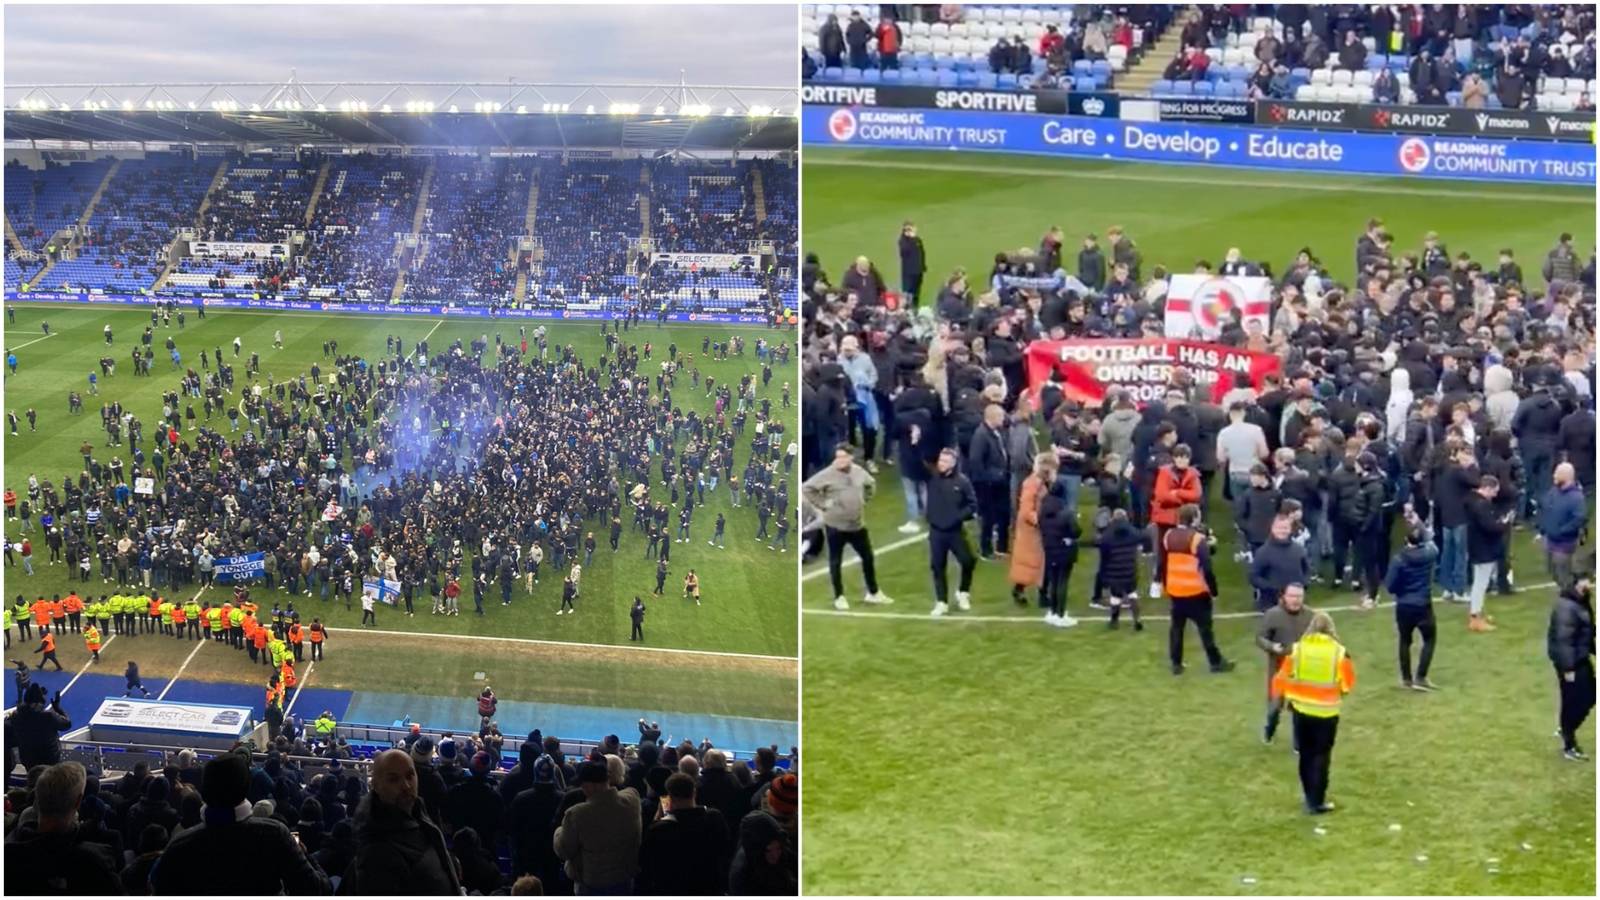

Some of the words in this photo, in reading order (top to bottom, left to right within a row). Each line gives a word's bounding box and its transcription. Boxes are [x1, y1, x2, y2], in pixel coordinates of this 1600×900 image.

[802, 86, 876, 105] ORTFIVE
[935, 90, 1037, 111] SPORTFIVE
[1183, 102, 1199, 114] FOR
[859, 112, 908, 123] READING
[910, 114, 924, 124] FC
[1287, 108, 1342, 122] RAPIDZ
[1392, 113, 1447, 127] RAPIDZ
[1489, 117, 1530, 128] macron
[1560, 120, 1593, 131] macro
[859, 125, 953, 141] COMMUNITY
[957, 127, 1007, 144] TRUST
[1043, 121, 1096, 145] Care
[1124, 126, 1220, 159] Develop
[1249, 134, 1343, 161] Educate
[1434, 141, 1489, 155] READING
[1490, 144, 1506, 156] FC
[1434, 155, 1538, 174] COMMUNITY
[1543, 159, 1596, 177] TRUST
[213, 244, 246, 252] SELECT
[677, 255, 713, 263] SELECT
[384, 305, 406, 313] Develop
[1060, 344, 1174, 362] FOOTBALL
[1180, 345, 1218, 366] HAS
[1224, 353, 1252, 372] AN
[1096, 364, 1219, 383] OWNERHIP
[230, 555, 249, 565] DAI
[220, 561, 262, 572] YONGGE
[232, 570, 254, 580] OUT
[138, 709, 179, 718] SELECT
[181, 711, 206, 720] CAR
